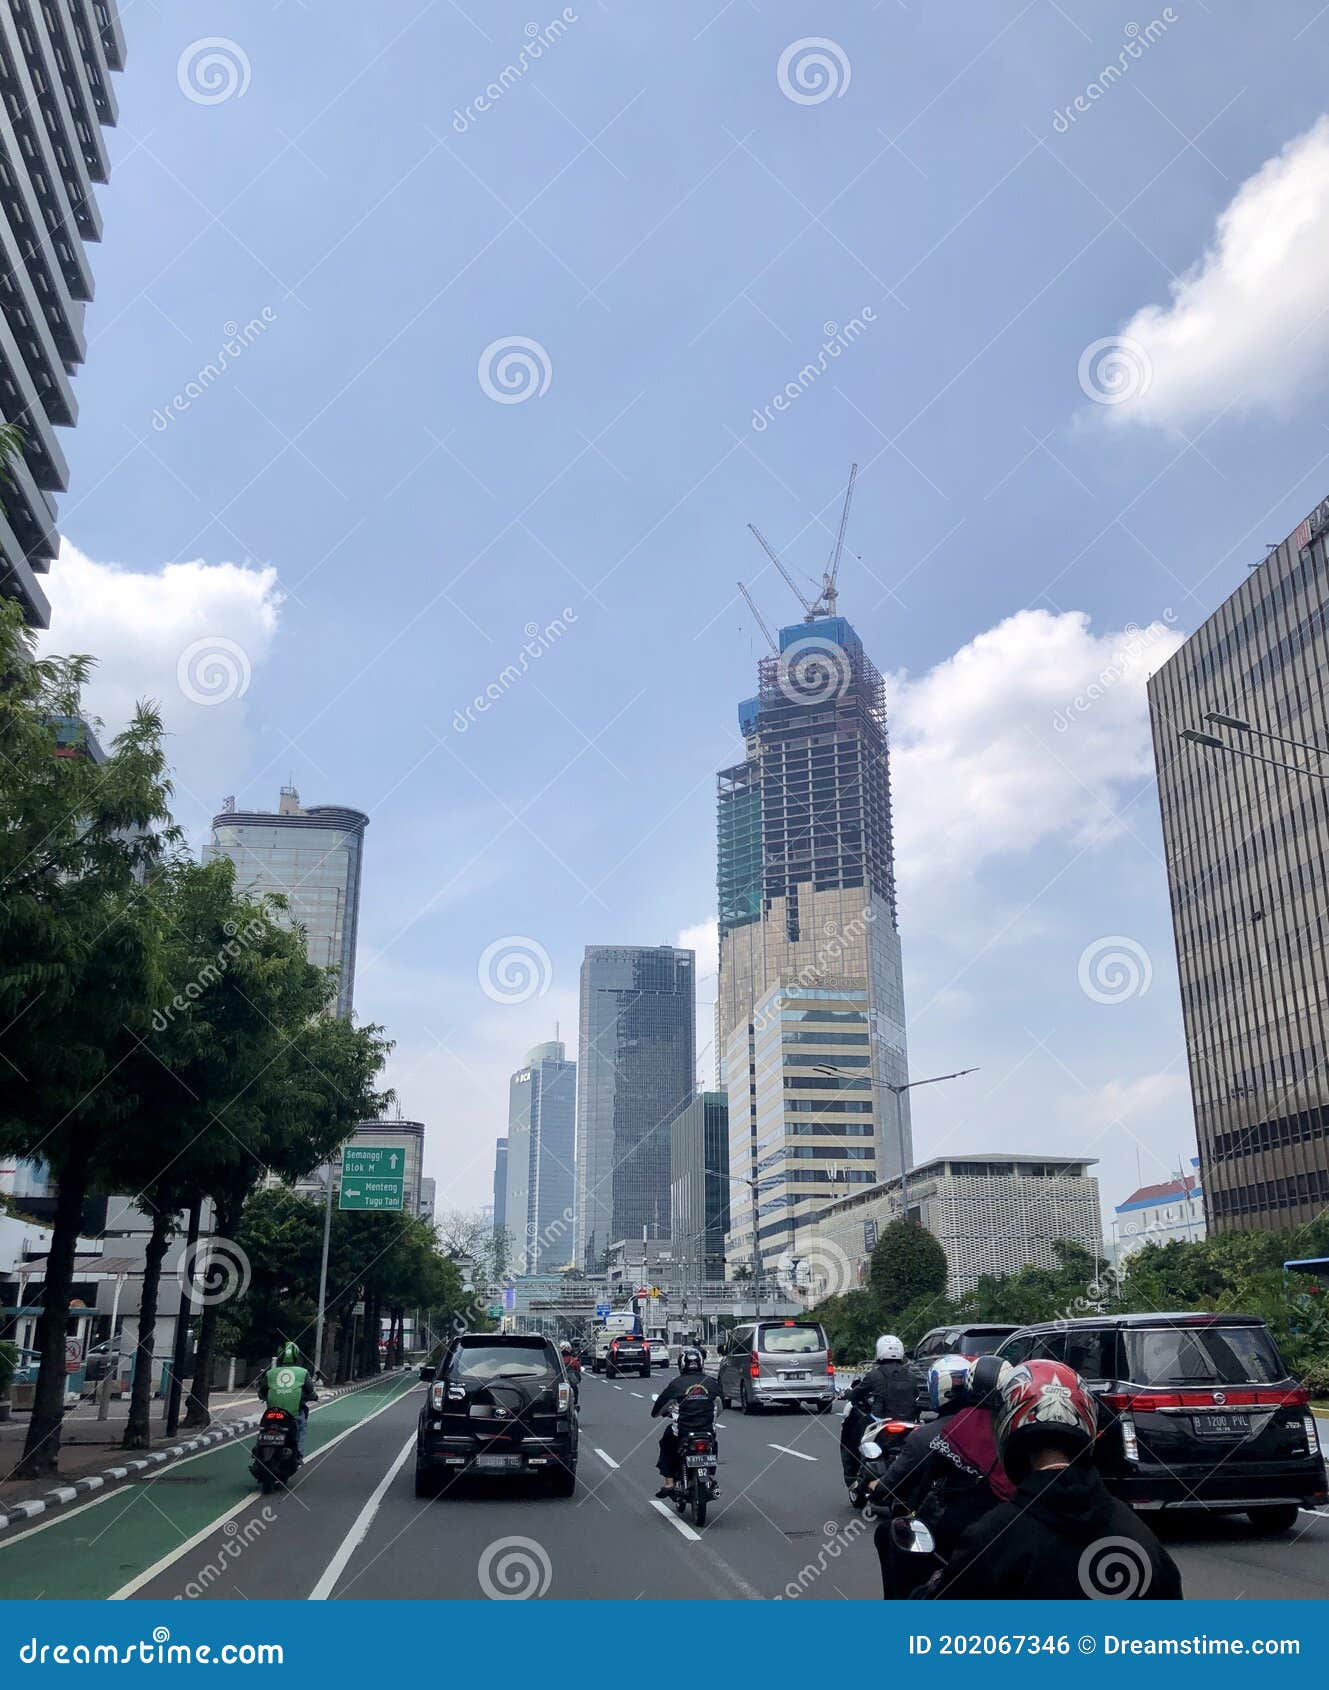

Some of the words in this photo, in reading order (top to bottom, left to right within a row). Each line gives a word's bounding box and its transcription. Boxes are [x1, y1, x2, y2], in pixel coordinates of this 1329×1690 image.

[346, 1150, 383, 1162] Semanggi
[345, 1163, 365, 1172] Blok
[368, 1164, 375, 1173] M
[365, 1183, 398, 1194] Menteng
[364, 1197, 383, 1208] Tugu
[384, 1197, 400, 1206] Tani
[1192, 1416, 1201, 1427] B
[1207, 1416, 1227, 1427] 1200
[1231, 1415, 1249, 1426] PVL
